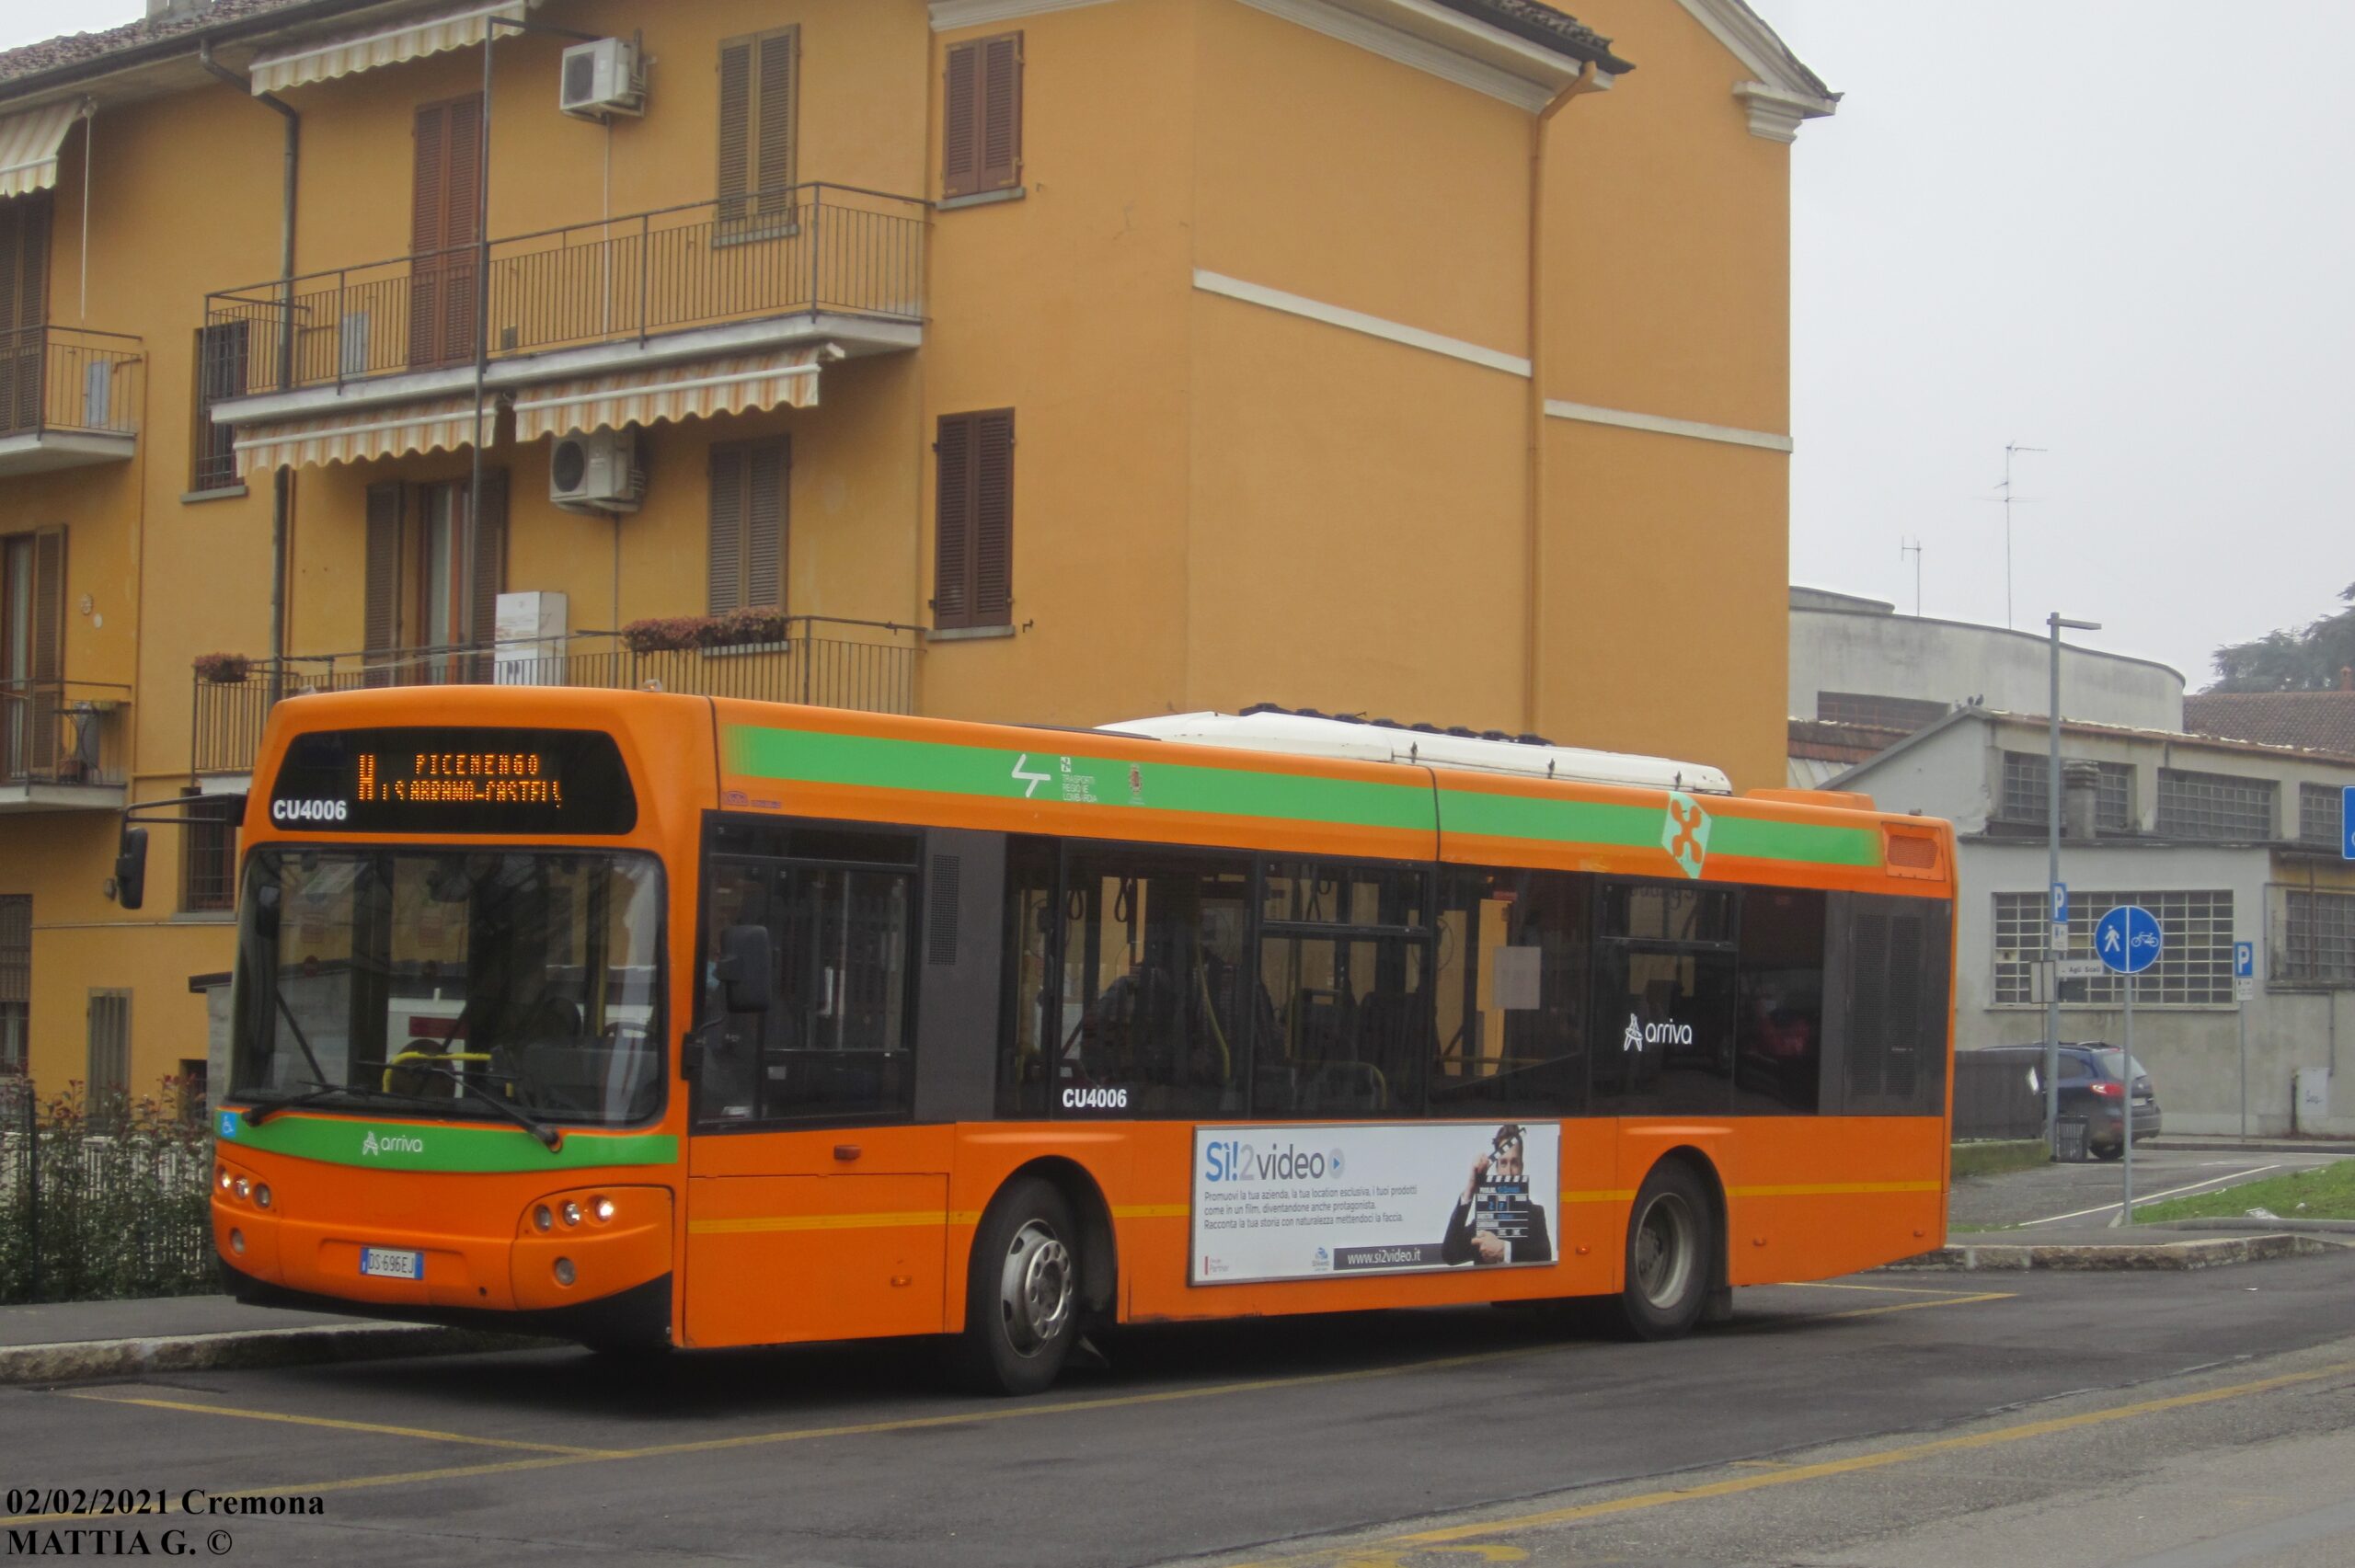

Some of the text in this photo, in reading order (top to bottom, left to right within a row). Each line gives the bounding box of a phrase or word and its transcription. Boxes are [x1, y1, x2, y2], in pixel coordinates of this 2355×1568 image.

[415, 754, 539, 775] PICENENGO
[273, 799, 347, 821] CU4006
[2054, 886, 2064, 919] P
[2238, 945, 2250, 974] P
[1645, 1017, 1693, 1045] arriva
[1062, 1088, 1127, 1108] CU4006
[380, 1134, 423, 1152] arriva
[1204, 1190, 1239, 1201] Promuovi
[1247, 1190, 1260, 1199] tua
[1299, 1189, 1311, 1198] tua
[1312, 1187, 1338, 1197] location
[1391, 1185, 1418, 1196] prodotti
[1204, 1206, 1224, 1215] come
[1226, 1205, 1233, 1214] in
[1234, 1206, 1244, 1214] un
[1311, 1202, 1331, 1211] anche
[1204, 1219, 1237, 1230] Racconta
[1246, 1219, 1258, 1228] tua
[1260, 1217, 1280, 1228] storia
[1281, 1218, 1294, 1227] con
